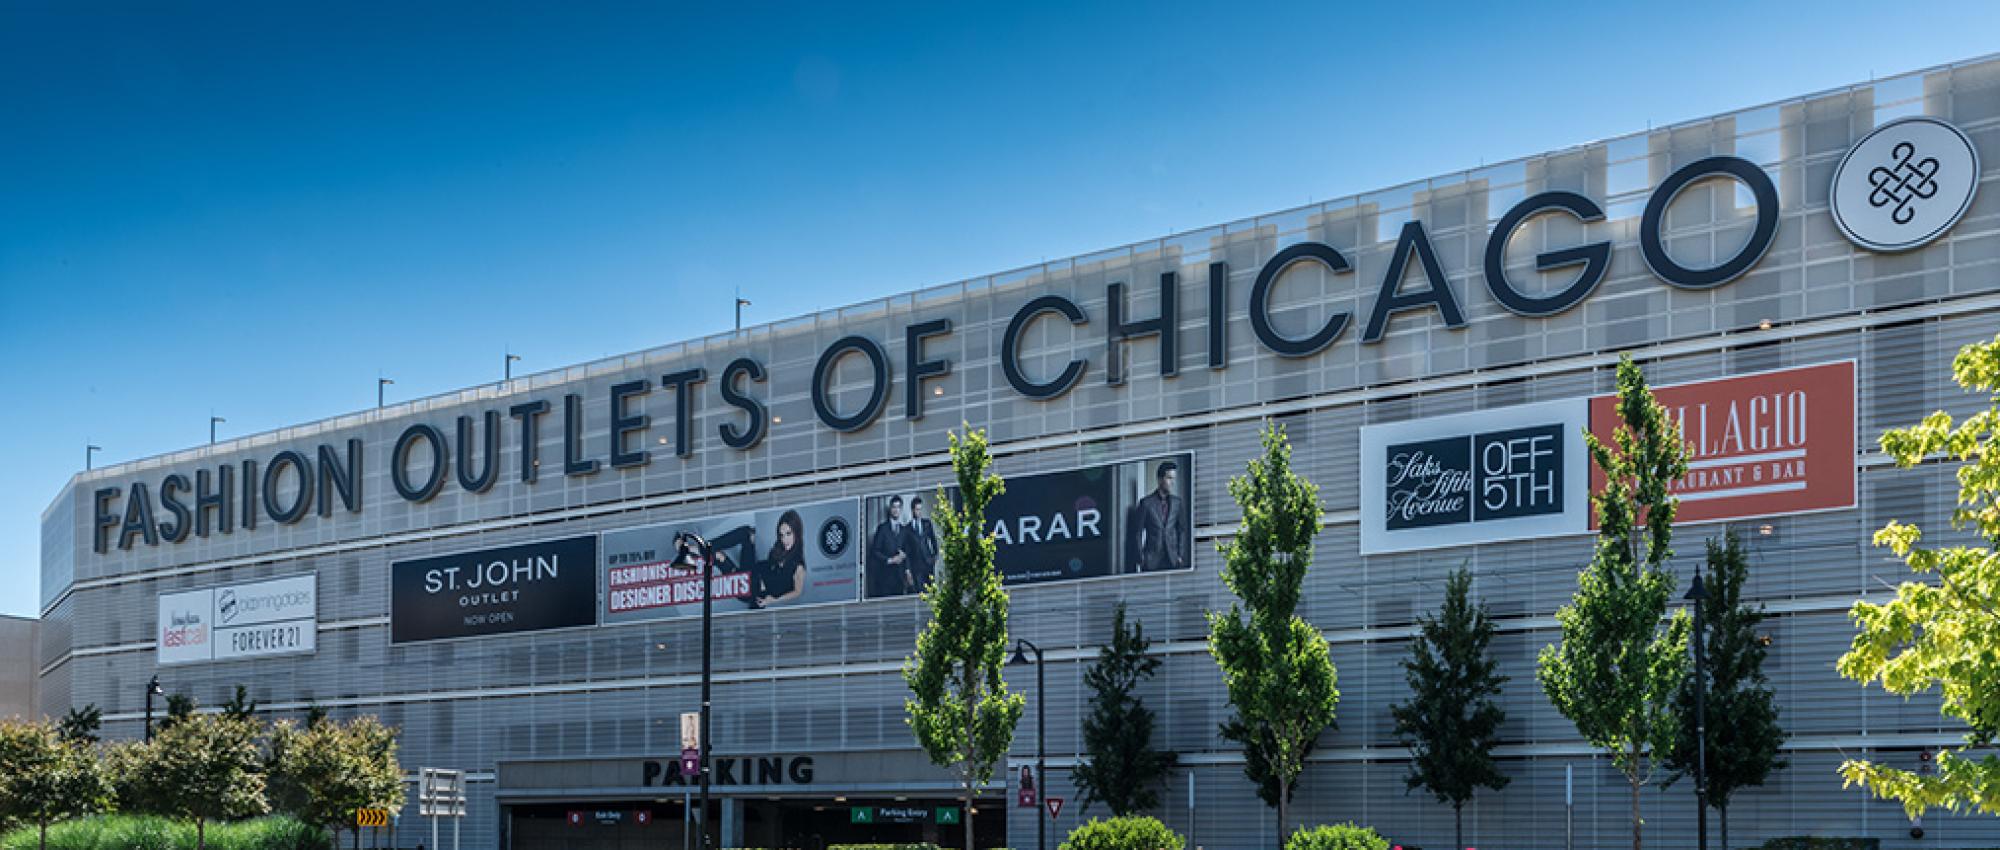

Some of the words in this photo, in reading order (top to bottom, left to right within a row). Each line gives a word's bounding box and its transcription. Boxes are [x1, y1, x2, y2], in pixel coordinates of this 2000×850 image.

[94, 438, 363, 554] FASHION
[391, 358, 767, 502] OUTLETS
[811, 318, 951, 433] OF
[1001, 156, 1780, 398] CHICAGO
[1634, 391, 1806, 460] LLAGIO
[1387, 451, 1440, 487] Saks
[1483, 435, 1553, 475] OFF
[1483, 470, 1553, 511] 5TH
[1636, 467, 1744, 490] TAURANT
[1772, 460, 1806, 480] BAR
[1387, 490, 1464, 521] Avenue
[964, 508, 1101, 545] ARAR
[425, 567, 461, 593] ST.
[467, 554, 558, 588] JOHN
[611, 584, 672, 610] DESIGNER
[674, 572, 750, 602] DISCUNTS
[459, 589, 520, 607] OUTLET
[463, 615, 486, 626] NOW
[488, 612, 514, 624] OPEN
[232, 628, 285, 652] FOREVER
[288, 626, 300, 648] 21
[643, 756, 813, 786] PAKING
